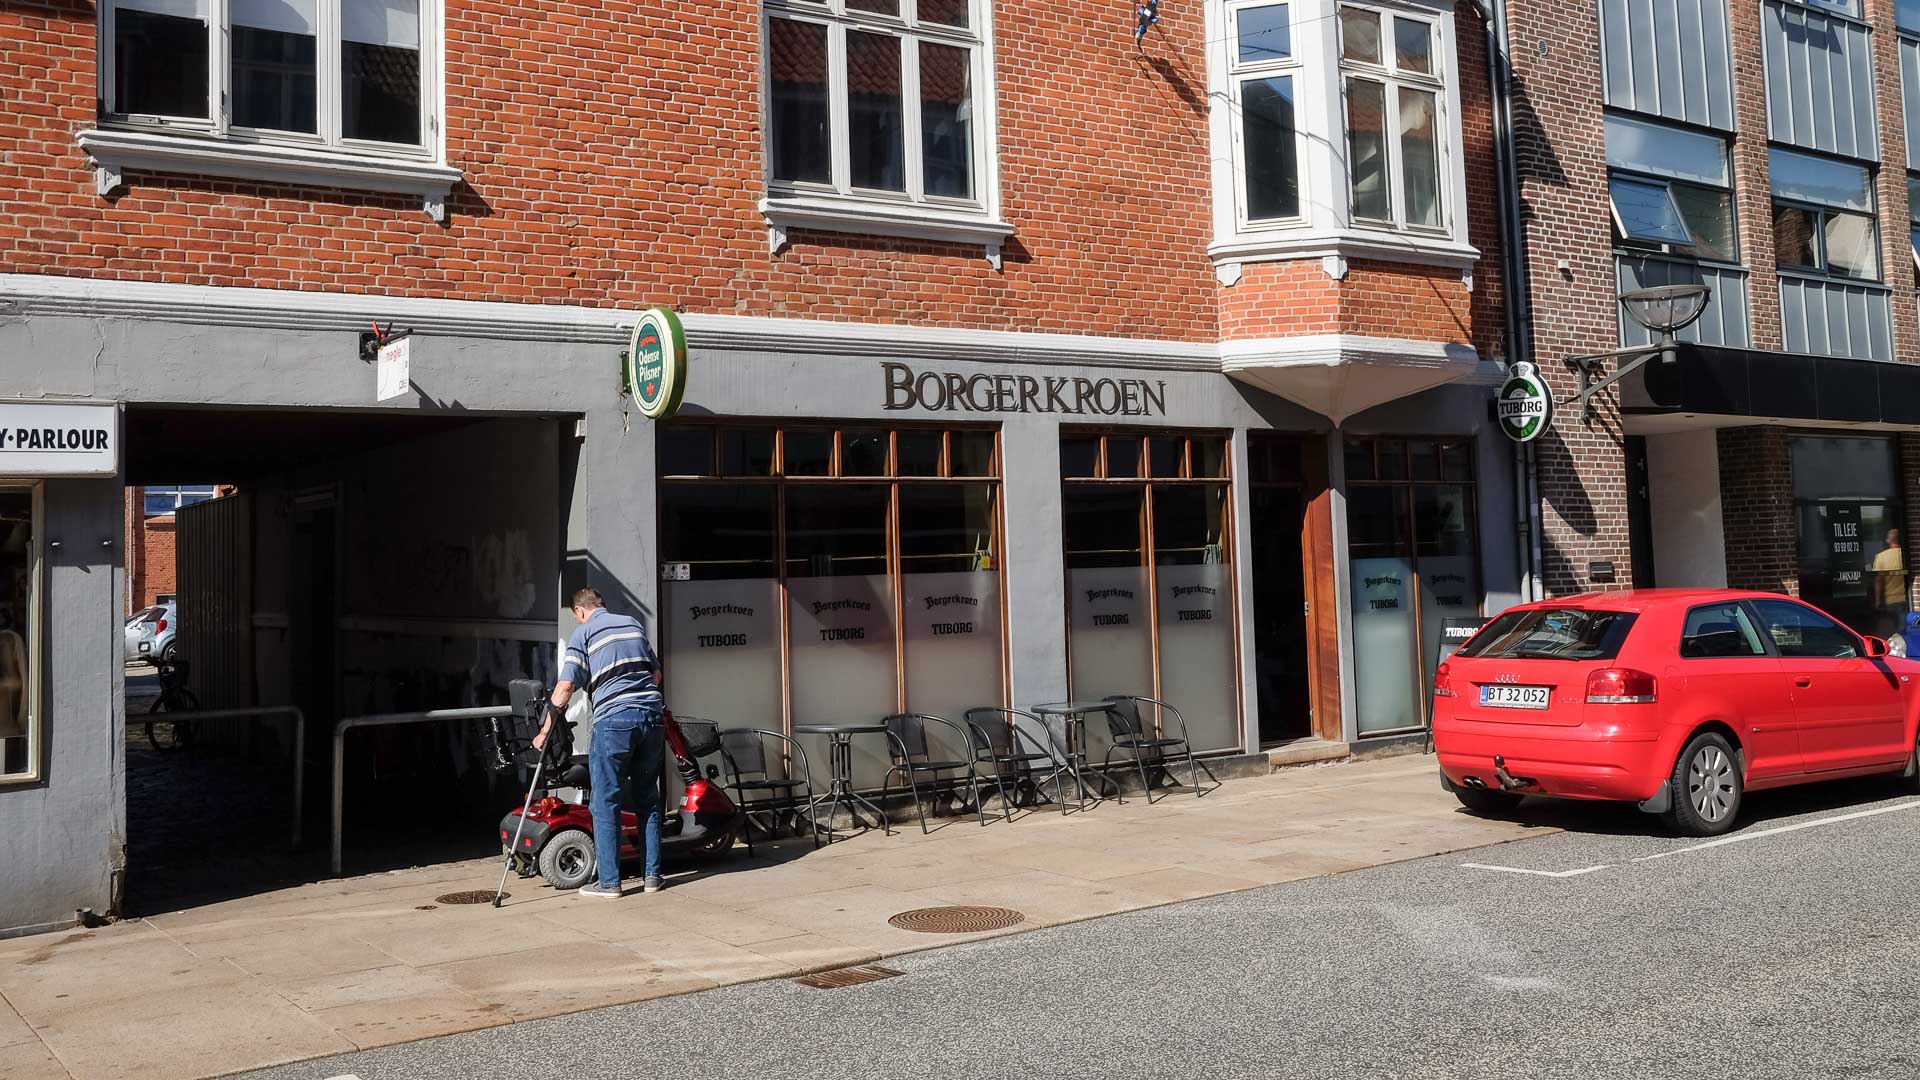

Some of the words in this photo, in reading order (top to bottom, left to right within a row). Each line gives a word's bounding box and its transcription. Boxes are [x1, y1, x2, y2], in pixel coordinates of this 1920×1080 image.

[638, 350, 660, 366] Odense
[639, 366, 661, 382] Pilsner
[1500, 401, 1542, 414] TUBORG
[1086, 587, 1133, 602] Borgerkroen
[1172, 584, 1216, 598] Borgerkroen
[813, 599, 871, 614] Borgerkroen
[924, 594, 978, 610] Borgerkroen
[1370, 599, 1398, 609] TUBORG
[690, 603, 754, 620] Borgerkroen
[1178, 610, 1212, 621] TUBORG
[1093, 614, 1129, 626] TUBORG
[820, 628, 864, 641] TUBORG
[932, 622, 973, 635] TUBORG
[698, 634, 747, 647] TUBORG
[1488, 687, 1503, 701] BT
[1506, 688, 1520, 701] 32
[1523, 689, 1546, 703] 052
